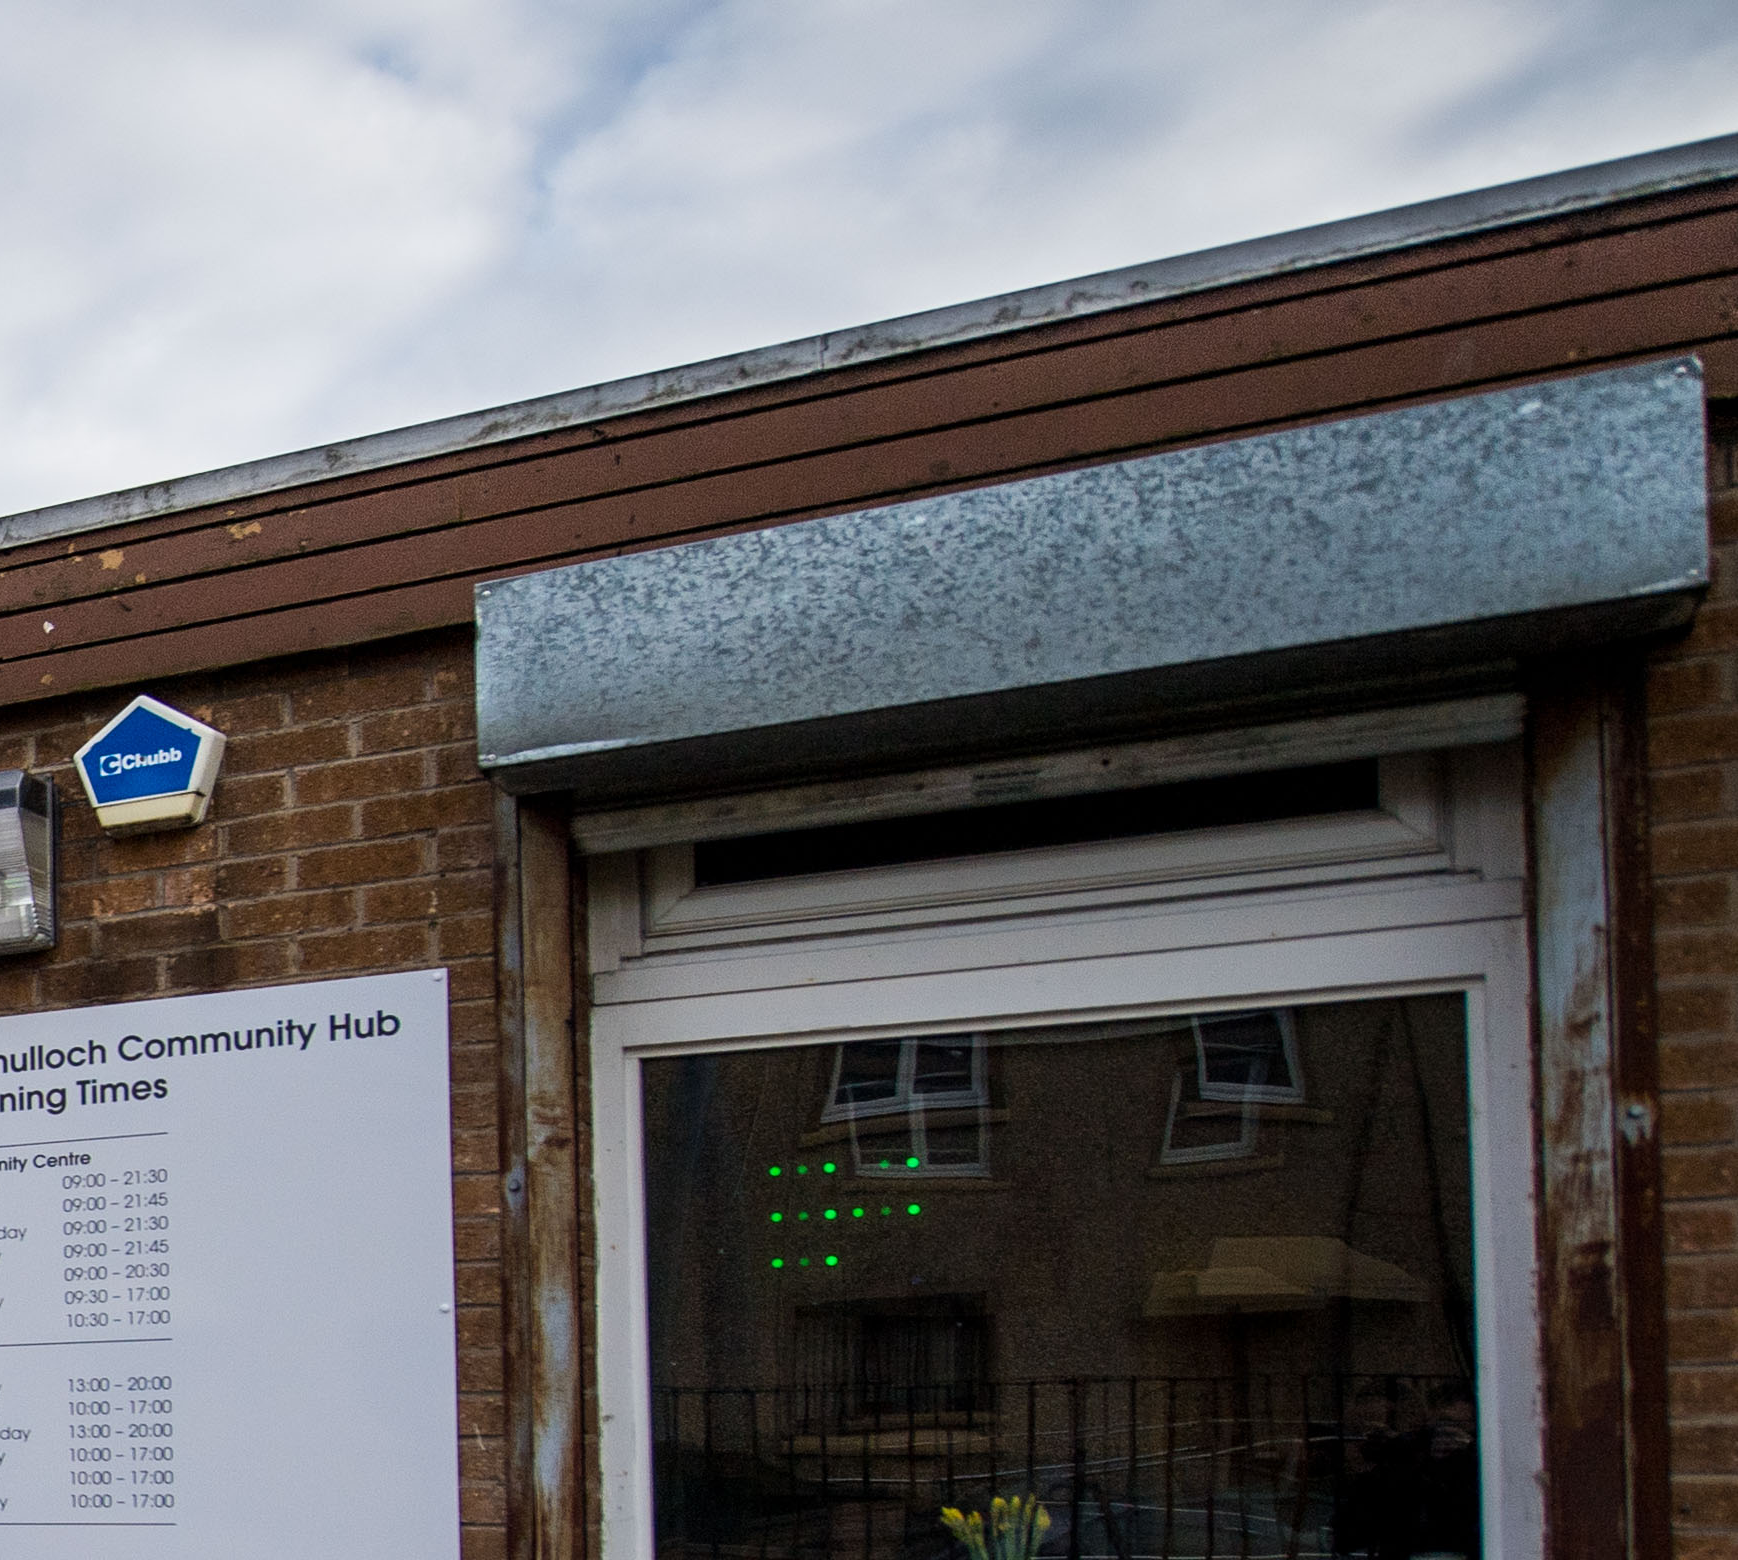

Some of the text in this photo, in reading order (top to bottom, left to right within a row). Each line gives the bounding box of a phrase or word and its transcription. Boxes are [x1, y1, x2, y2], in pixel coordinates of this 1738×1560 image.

[122, 747, 183, 770] Chubb
[117, 1018, 317, 1061] Community
[328, 1010, 401, 1042] Hub
[76, 1078, 169, 1106] Times
[32, 1151, 92, 1169] Centre
[62, 1173, 106, 1190] 09:00
[123, 1168, 168, 1185] 21:30
[63, 1196, 106, 1213] 09:00
[124, 1192, 169, 1209] 21:45
[63, 1219, 107, 1236] 09:00
[124, 1215, 169, 1232] 21:30
[64, 1243, 107, 1259] 09:00
[125, 1239, 170, 1256] 21:45
[64, 1266, 107, 1282] 09:00
[125, 1262, 170, 1279] 20:30
[64, 1289, 108, 1305] 09:30
[127, 1286, 170, 1302] 17:00
[67, 1312, 108, 1328] 10:30
[127, 1310, 171, 1326] 17:00
[68, 1377, 110, 1392] 13:00
[127, 1376, 172, 1391] 20:00
[69, 1401, 110, 1416] 10:00
[130, 1399, 172, 1414] 17:00
[69, 1424, 111, 1438] 13:00
[128, 1423, 173, 1438] 20:00
[69, 1447, 111, 1462] 10:00
[130, 1446, 173, 1461] 17:00
[70, 1471, 112, 1485] 10:00
[131, 1470, 174, 1484] 17:00
[70, 1494, 112, 1508] 10:00
[131, 1494, 174, 1508] 17:00
